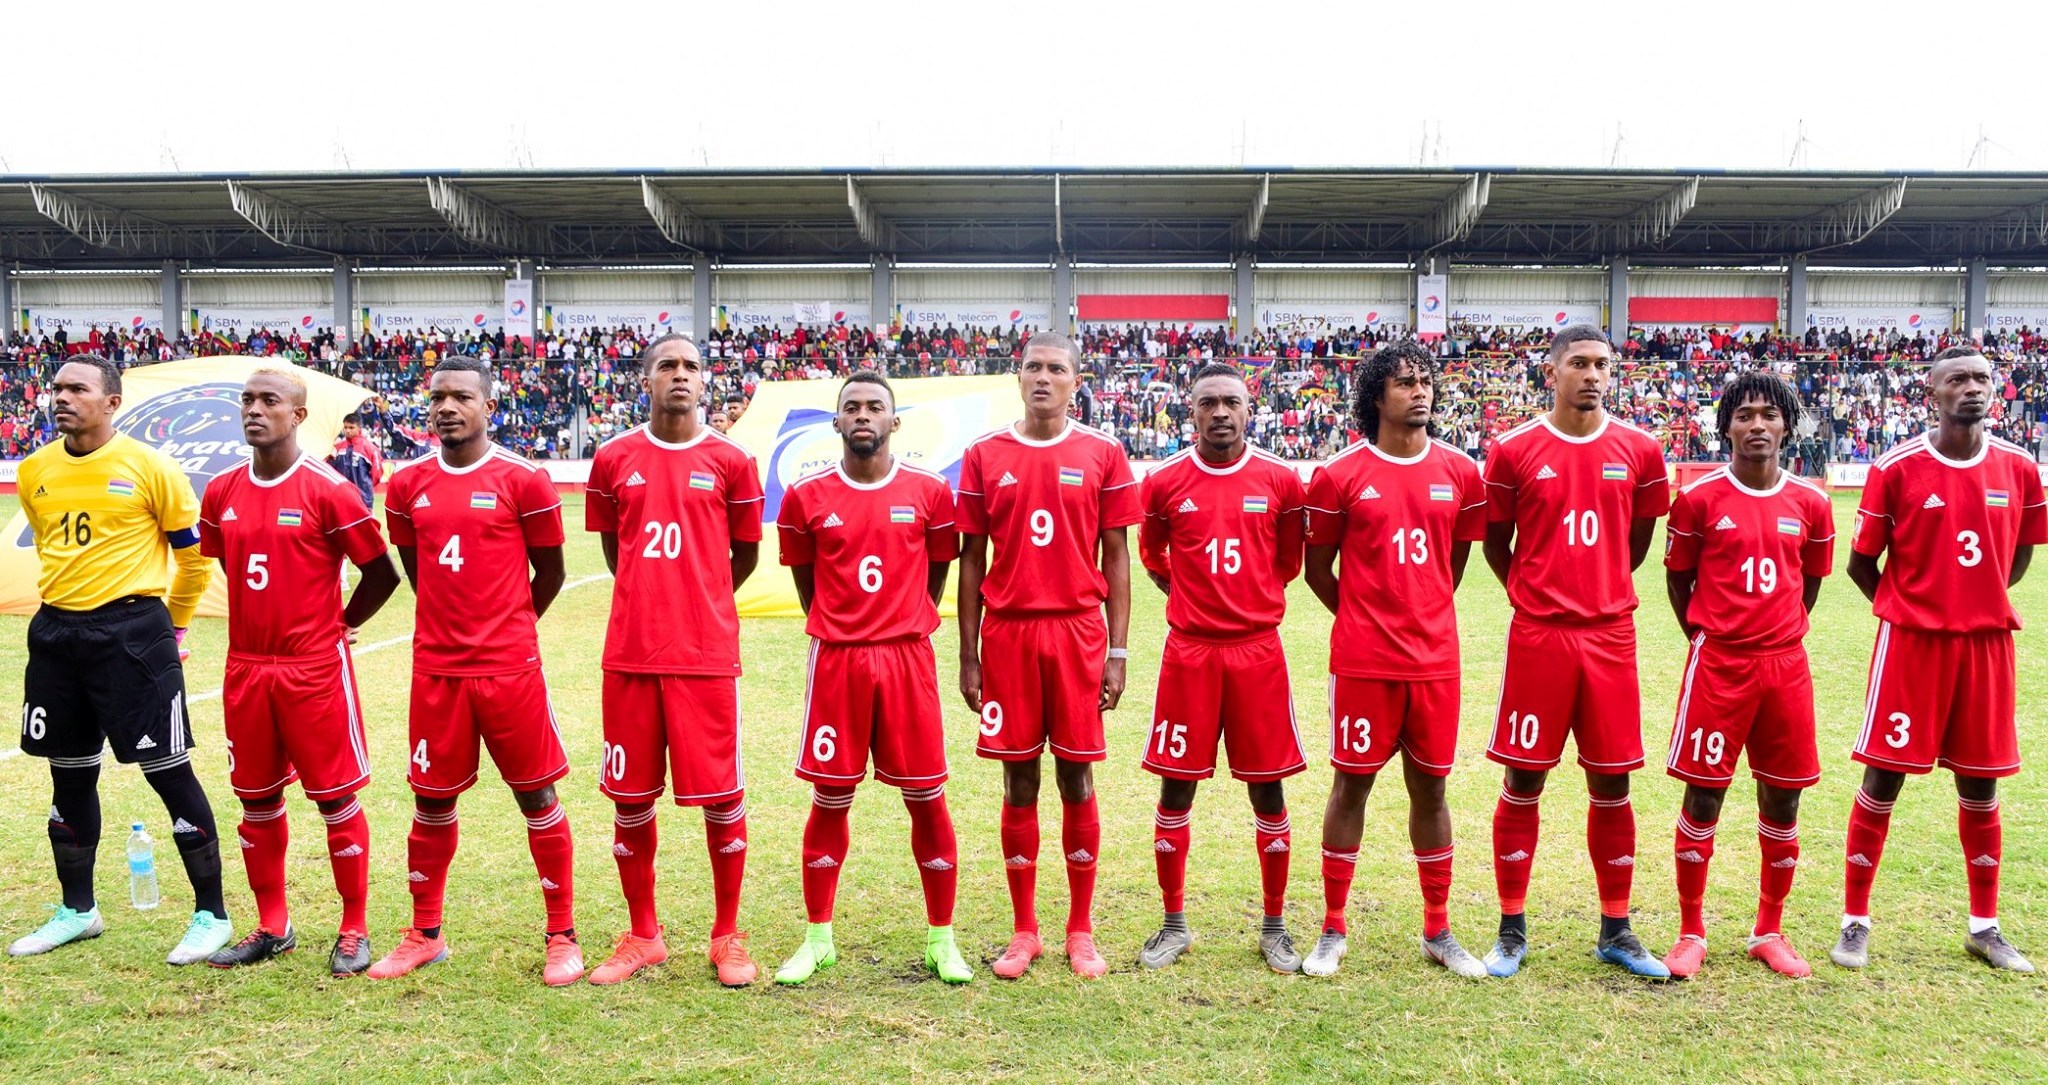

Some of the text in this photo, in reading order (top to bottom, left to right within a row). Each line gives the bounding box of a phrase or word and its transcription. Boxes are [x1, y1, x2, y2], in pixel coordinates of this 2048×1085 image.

[46, 319, 73, 327] SBM
[83, 319, 121, 328] telecom
[215, 318, 242, 327] SBM
[252, 319, 291, 328] telecom
[386, 316, 414, 325] SBM
[423, 316, 463, 325] telecom
[569, 314, 597, 324] SBM
[607, 314, 647, 324] telecom
[744, 314, 771, 323] SBM
[918, 312, 947, 322] SBM
[957, 312, 998, 322] telecom
[1275, 313, 1302, 322] SBM
[1465, 313, 1492, 323] SBM
[1503, 314, 1543, 323] telecom
[1819, 316, 1846, 326] SBM
[1857, 316, 1897, 326] telecom
[1996, 316, 2024, 326] SBM
[800, 459, 832, 469] MY
[60, 511, 92, 547] 16
[642, 520, 681, 560] 20
[1030, 509, 1054, 547] 9
[1392, 527, 1429, 565] 13
[1563, 509, 1599, 547] 10
[438, 534, 464, 572] 4
[1205, 537, 1241, 575] 15
[1956, 529, 1982, 567] 3
[246, 553, 269, 591] 5
[858, 554, 883, 593] 6
[1740, 556, 1777, 594] 19
[22, 702, 47, 740] 16
[980, 700, 1003, 737] 9
[1340, 715, 1371, 754] 13
[1508, 710, 1539, 749] 10
[1885, 711, 1911, 749] 3
[412, 738, 431, 774] 4
[812, 724, 837, 762] 6
[1155, 719, 1188, 759] 15
[1690, 727, 1725, 766] 19
